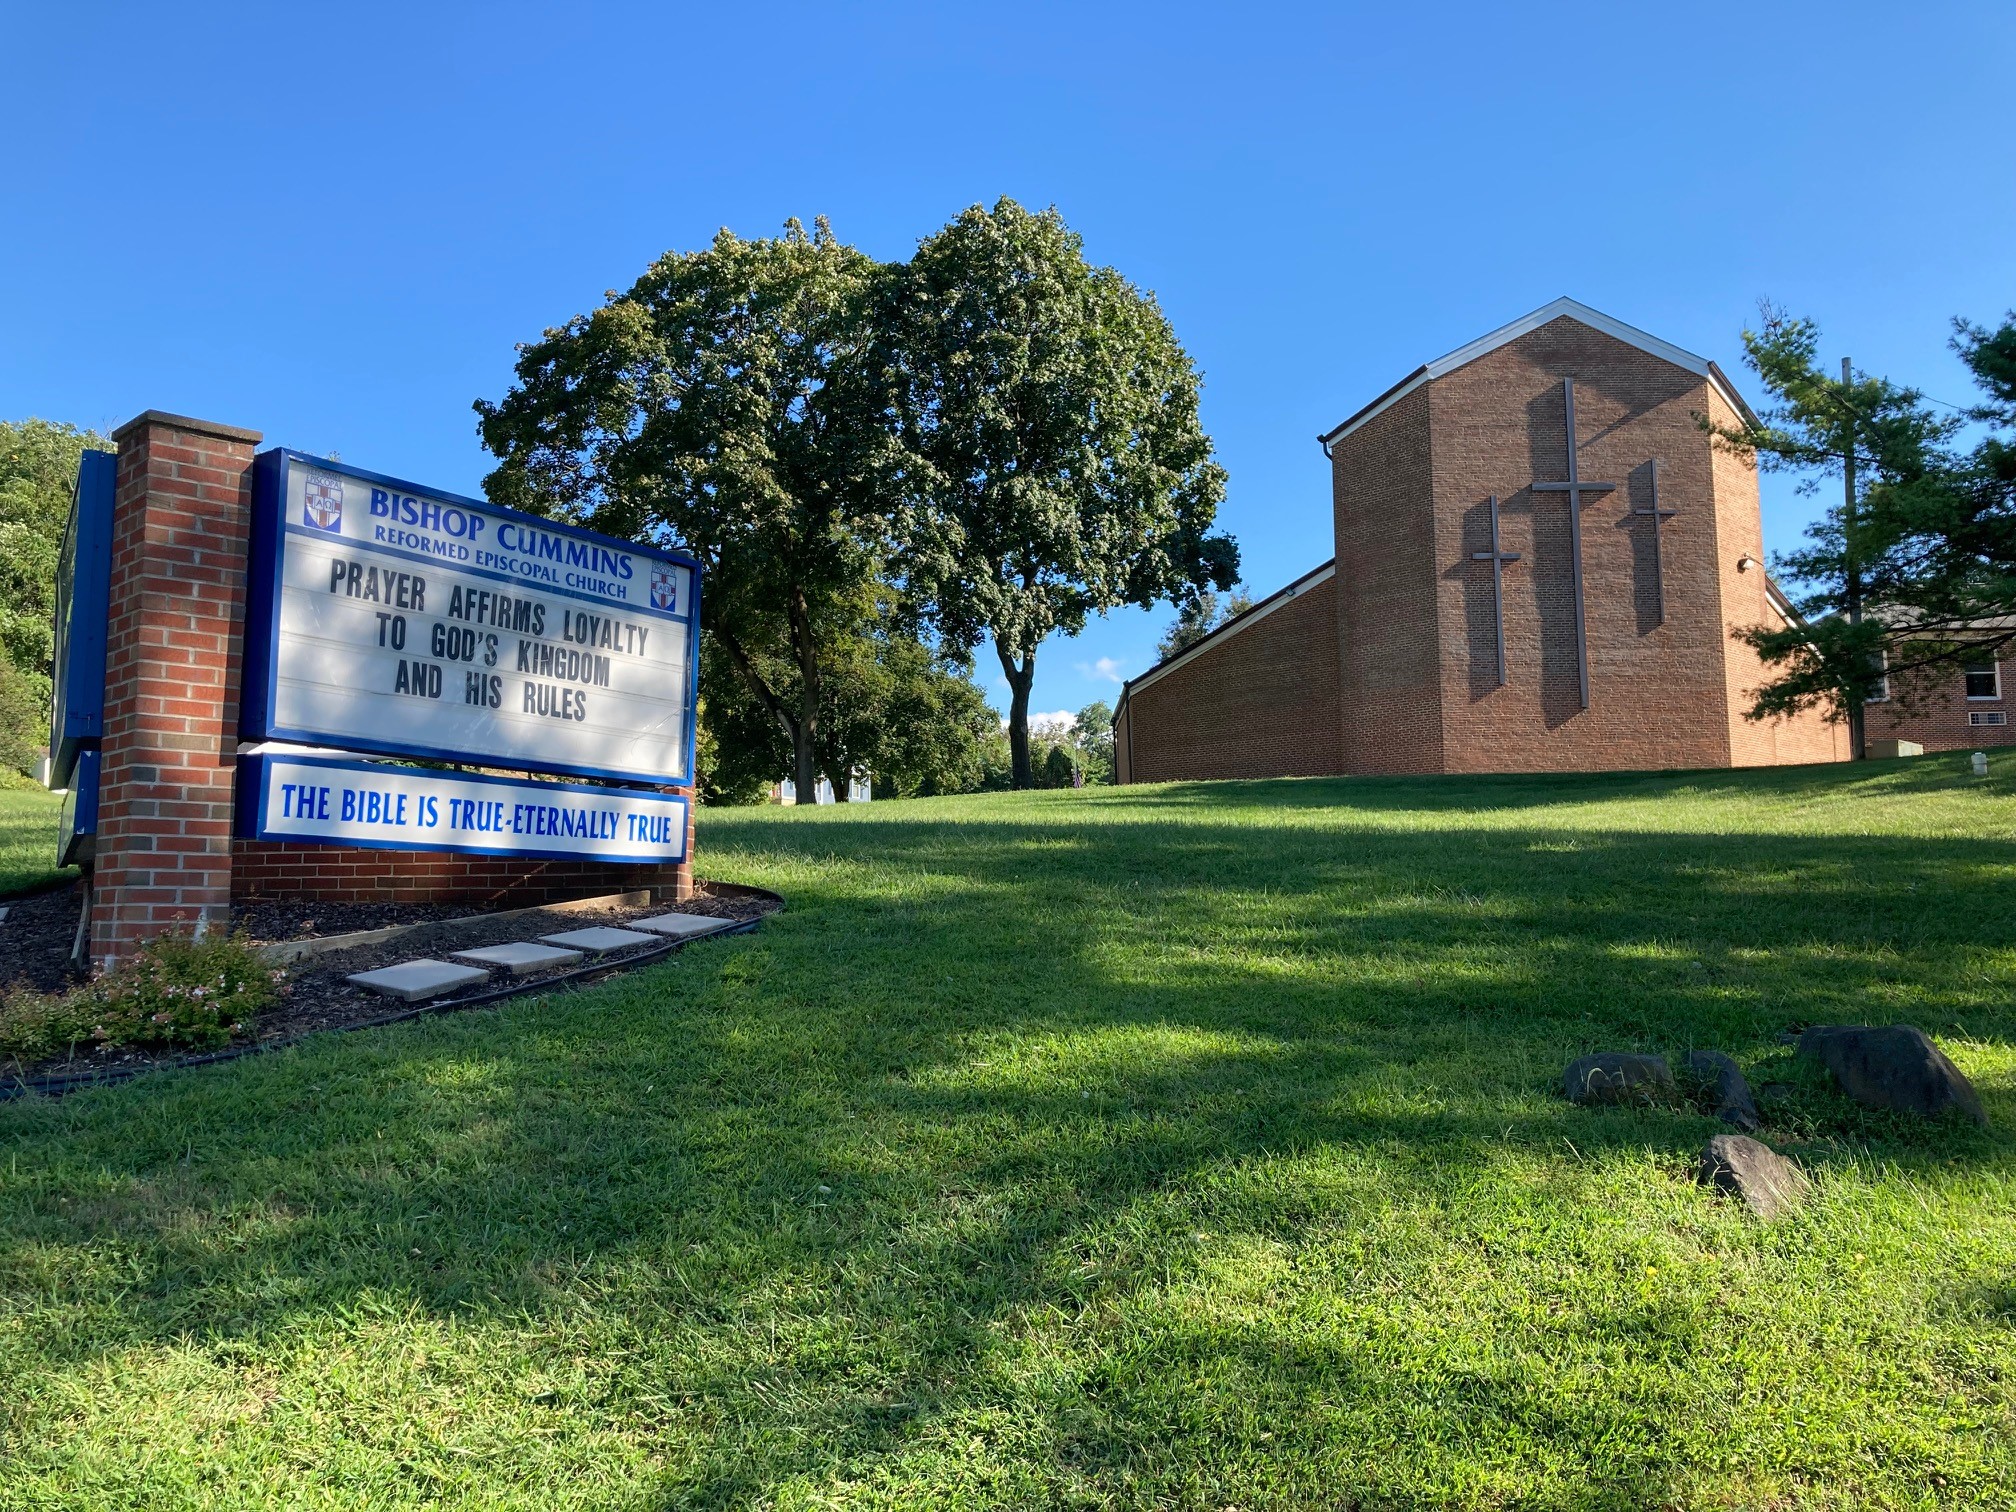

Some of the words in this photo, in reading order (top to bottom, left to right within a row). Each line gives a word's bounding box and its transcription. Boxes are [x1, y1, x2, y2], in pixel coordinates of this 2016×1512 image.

[370, 488, 485, 540] BISHOP
[497, 523, 633, 579] CUMMINS
[375, 525, 469, 560] REFORMED
[476, 550, 559, 583] EPISCOPAL
[566, 573, 626, 599] CHURCH
[331, 558, 426, 612] PRAYER
[448, 585, 544, 636] AFFIRMS
[563, 610, 648, 656] LOYALTY
[376, 612, 406, 650] TO
[432, 622, 498, 666] GOD'S
[517, 640, 610, 687] KINGDOM
[395, 660, 442, 698] AND
[466, 671, 502, 708] HIS
[523, 681, 586, 721] RULES
[282, 784, 330, 820] THE
[341, 788, 407, 825] BIBLE
[417, 796, 438, 828] IS
[627, 814, 672, 844] TRUE
